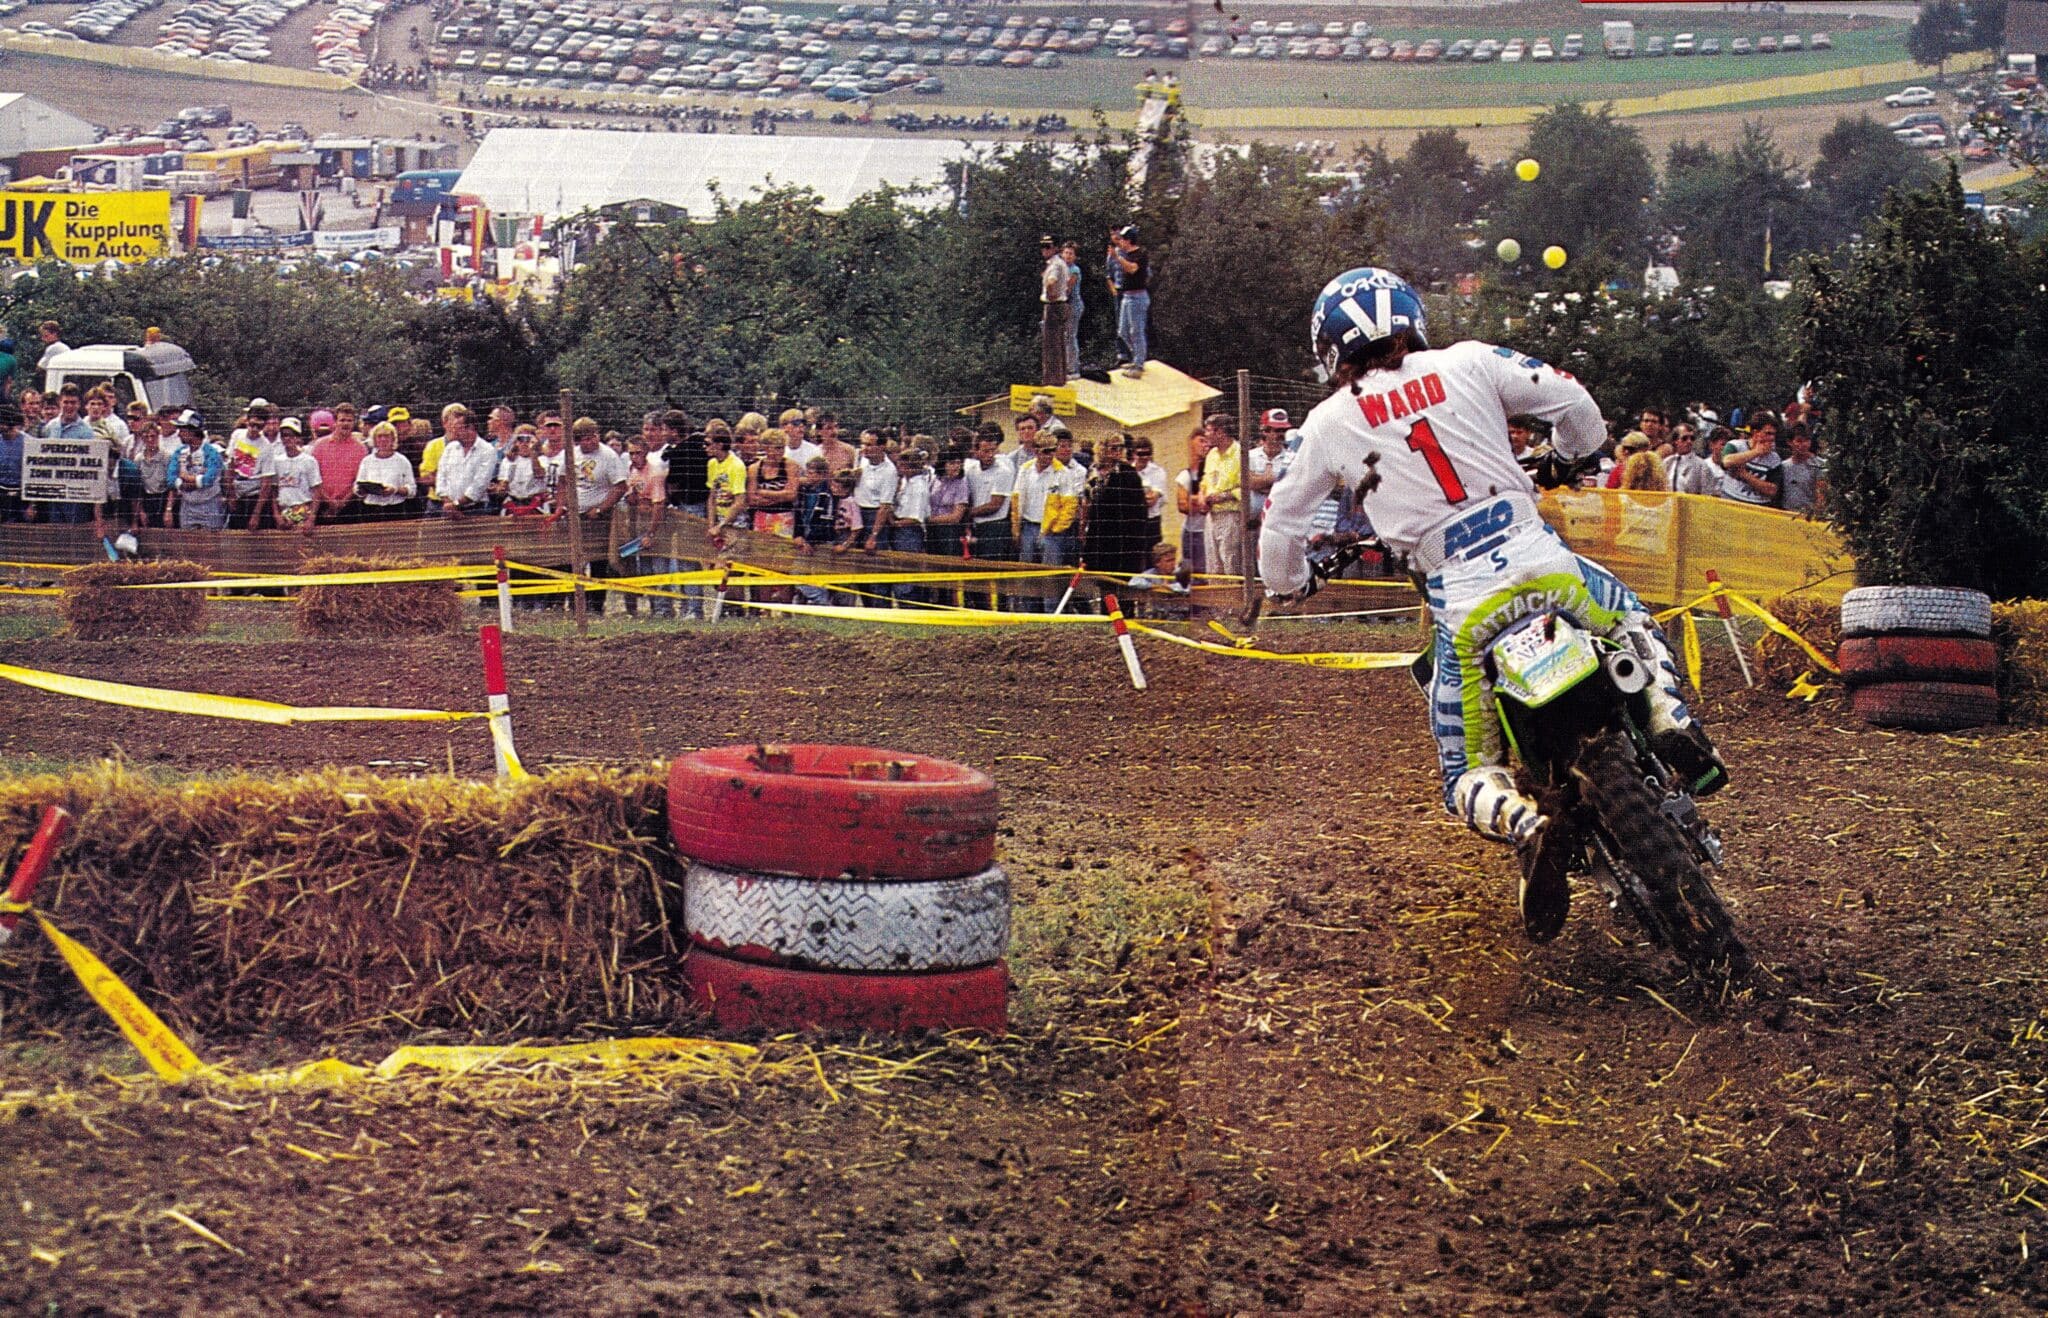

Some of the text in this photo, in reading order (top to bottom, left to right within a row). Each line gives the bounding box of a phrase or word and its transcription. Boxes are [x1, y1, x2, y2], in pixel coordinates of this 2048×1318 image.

[66, 201, 98, 217] Die
[0, 199, 56, 258] UK
[66, 221, 163, 241] Kupplung
[65, 242, 90, 258] im
[1357, 373, 1446, 429] WARD
[26, 456, 103, 467] PROHIBITED AREA
[1405, 416, 1468, 506] 1
[1490, 549, 1509, 572] S
